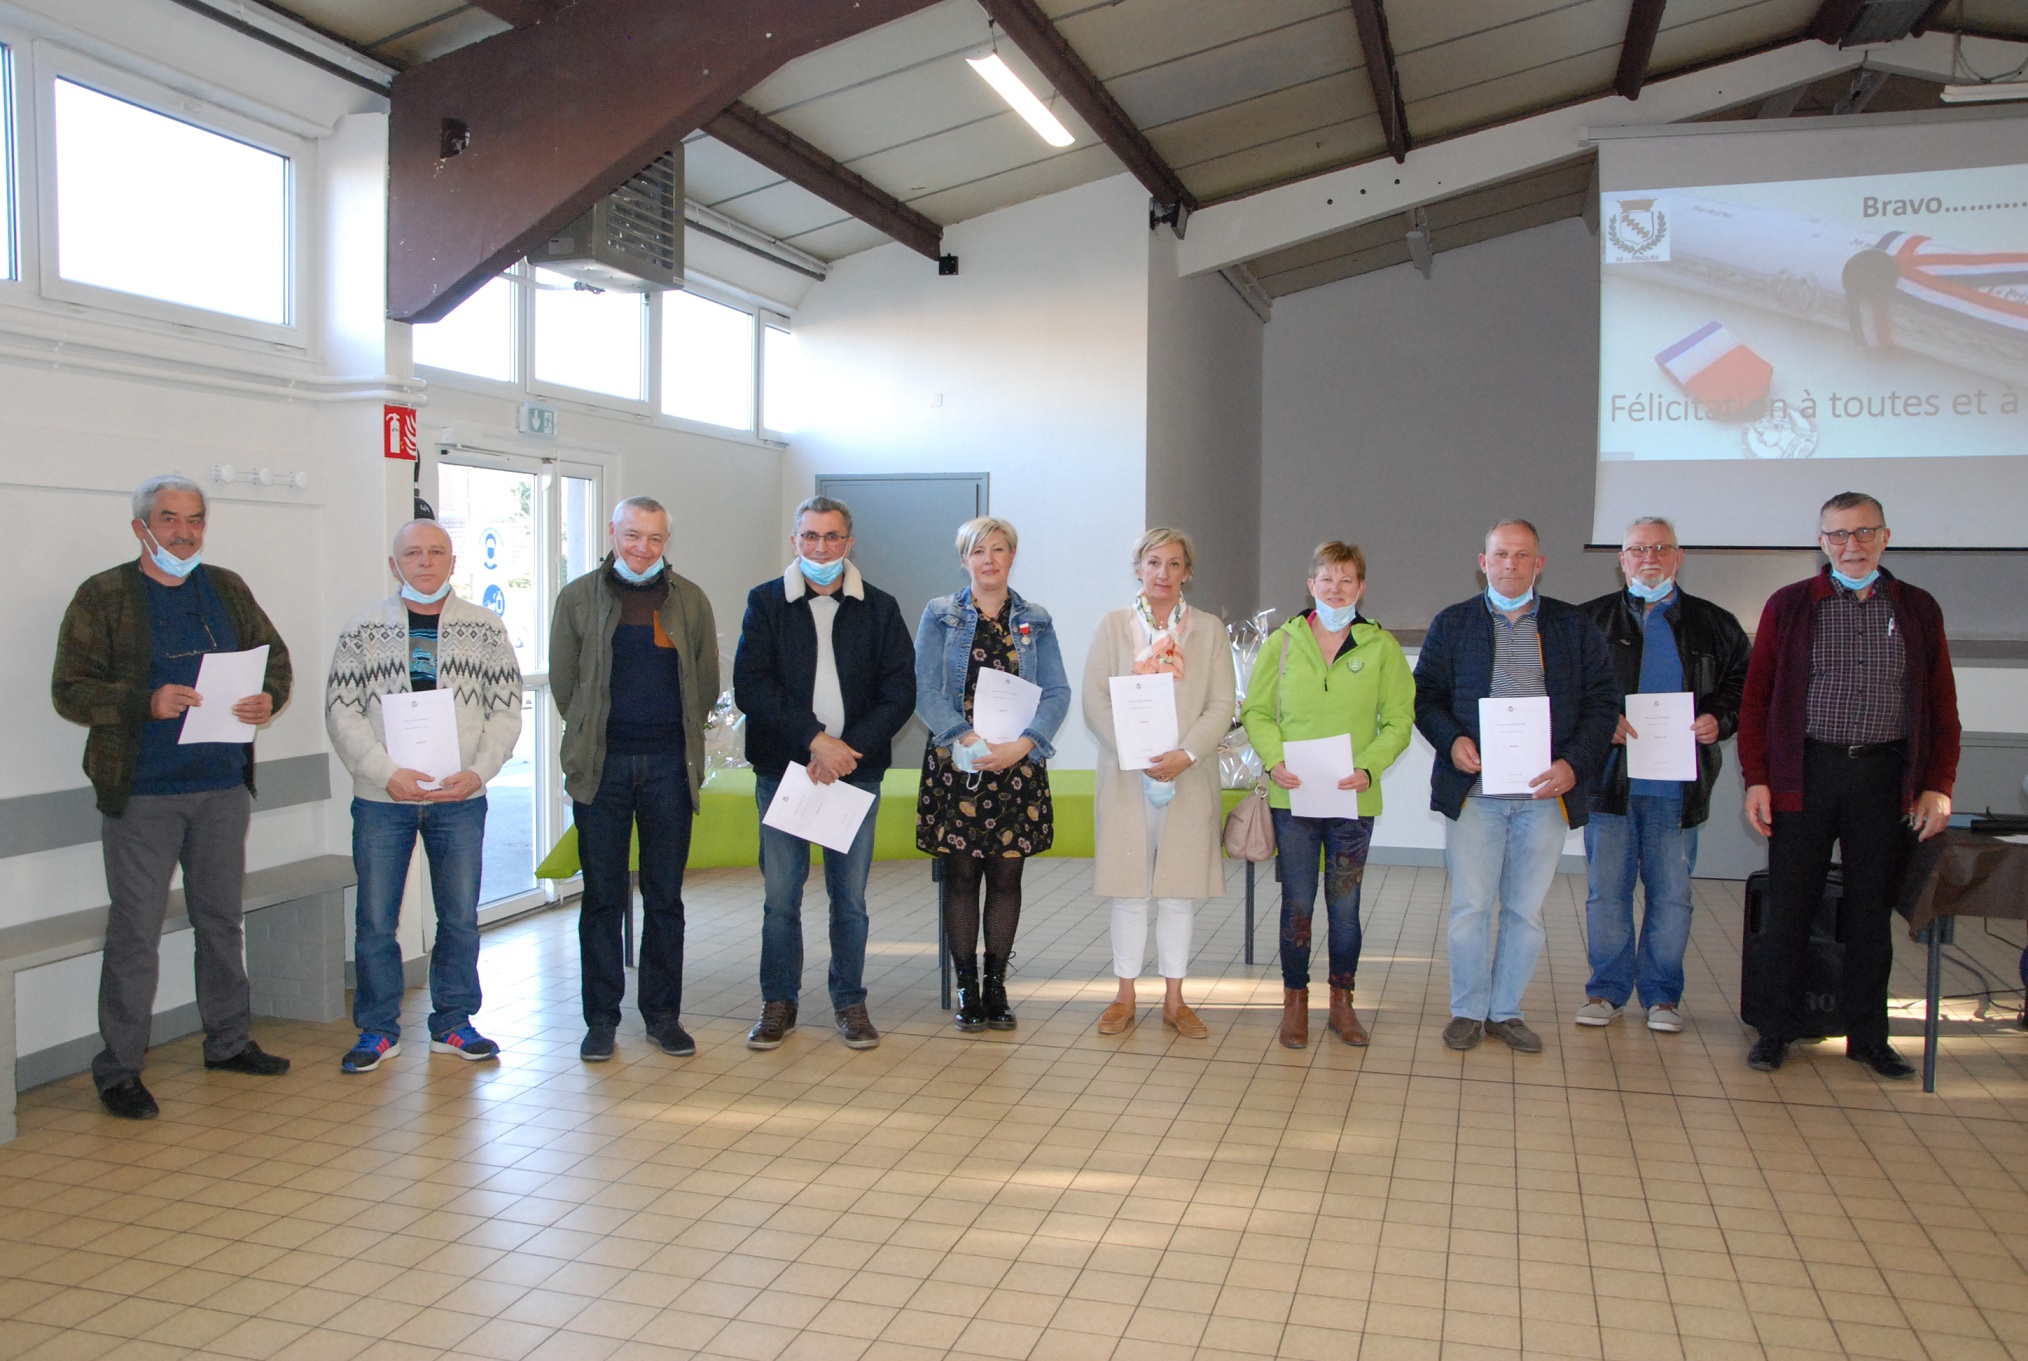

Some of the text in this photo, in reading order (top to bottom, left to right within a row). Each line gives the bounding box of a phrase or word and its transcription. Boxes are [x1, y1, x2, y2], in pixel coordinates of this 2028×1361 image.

[1611, 392, 1788, 422] Félicitatin
[1800, 389, 1816, 419] à
[1829, 391, 1940, 418] toutes
[1952, 389, 1988, 416] et
